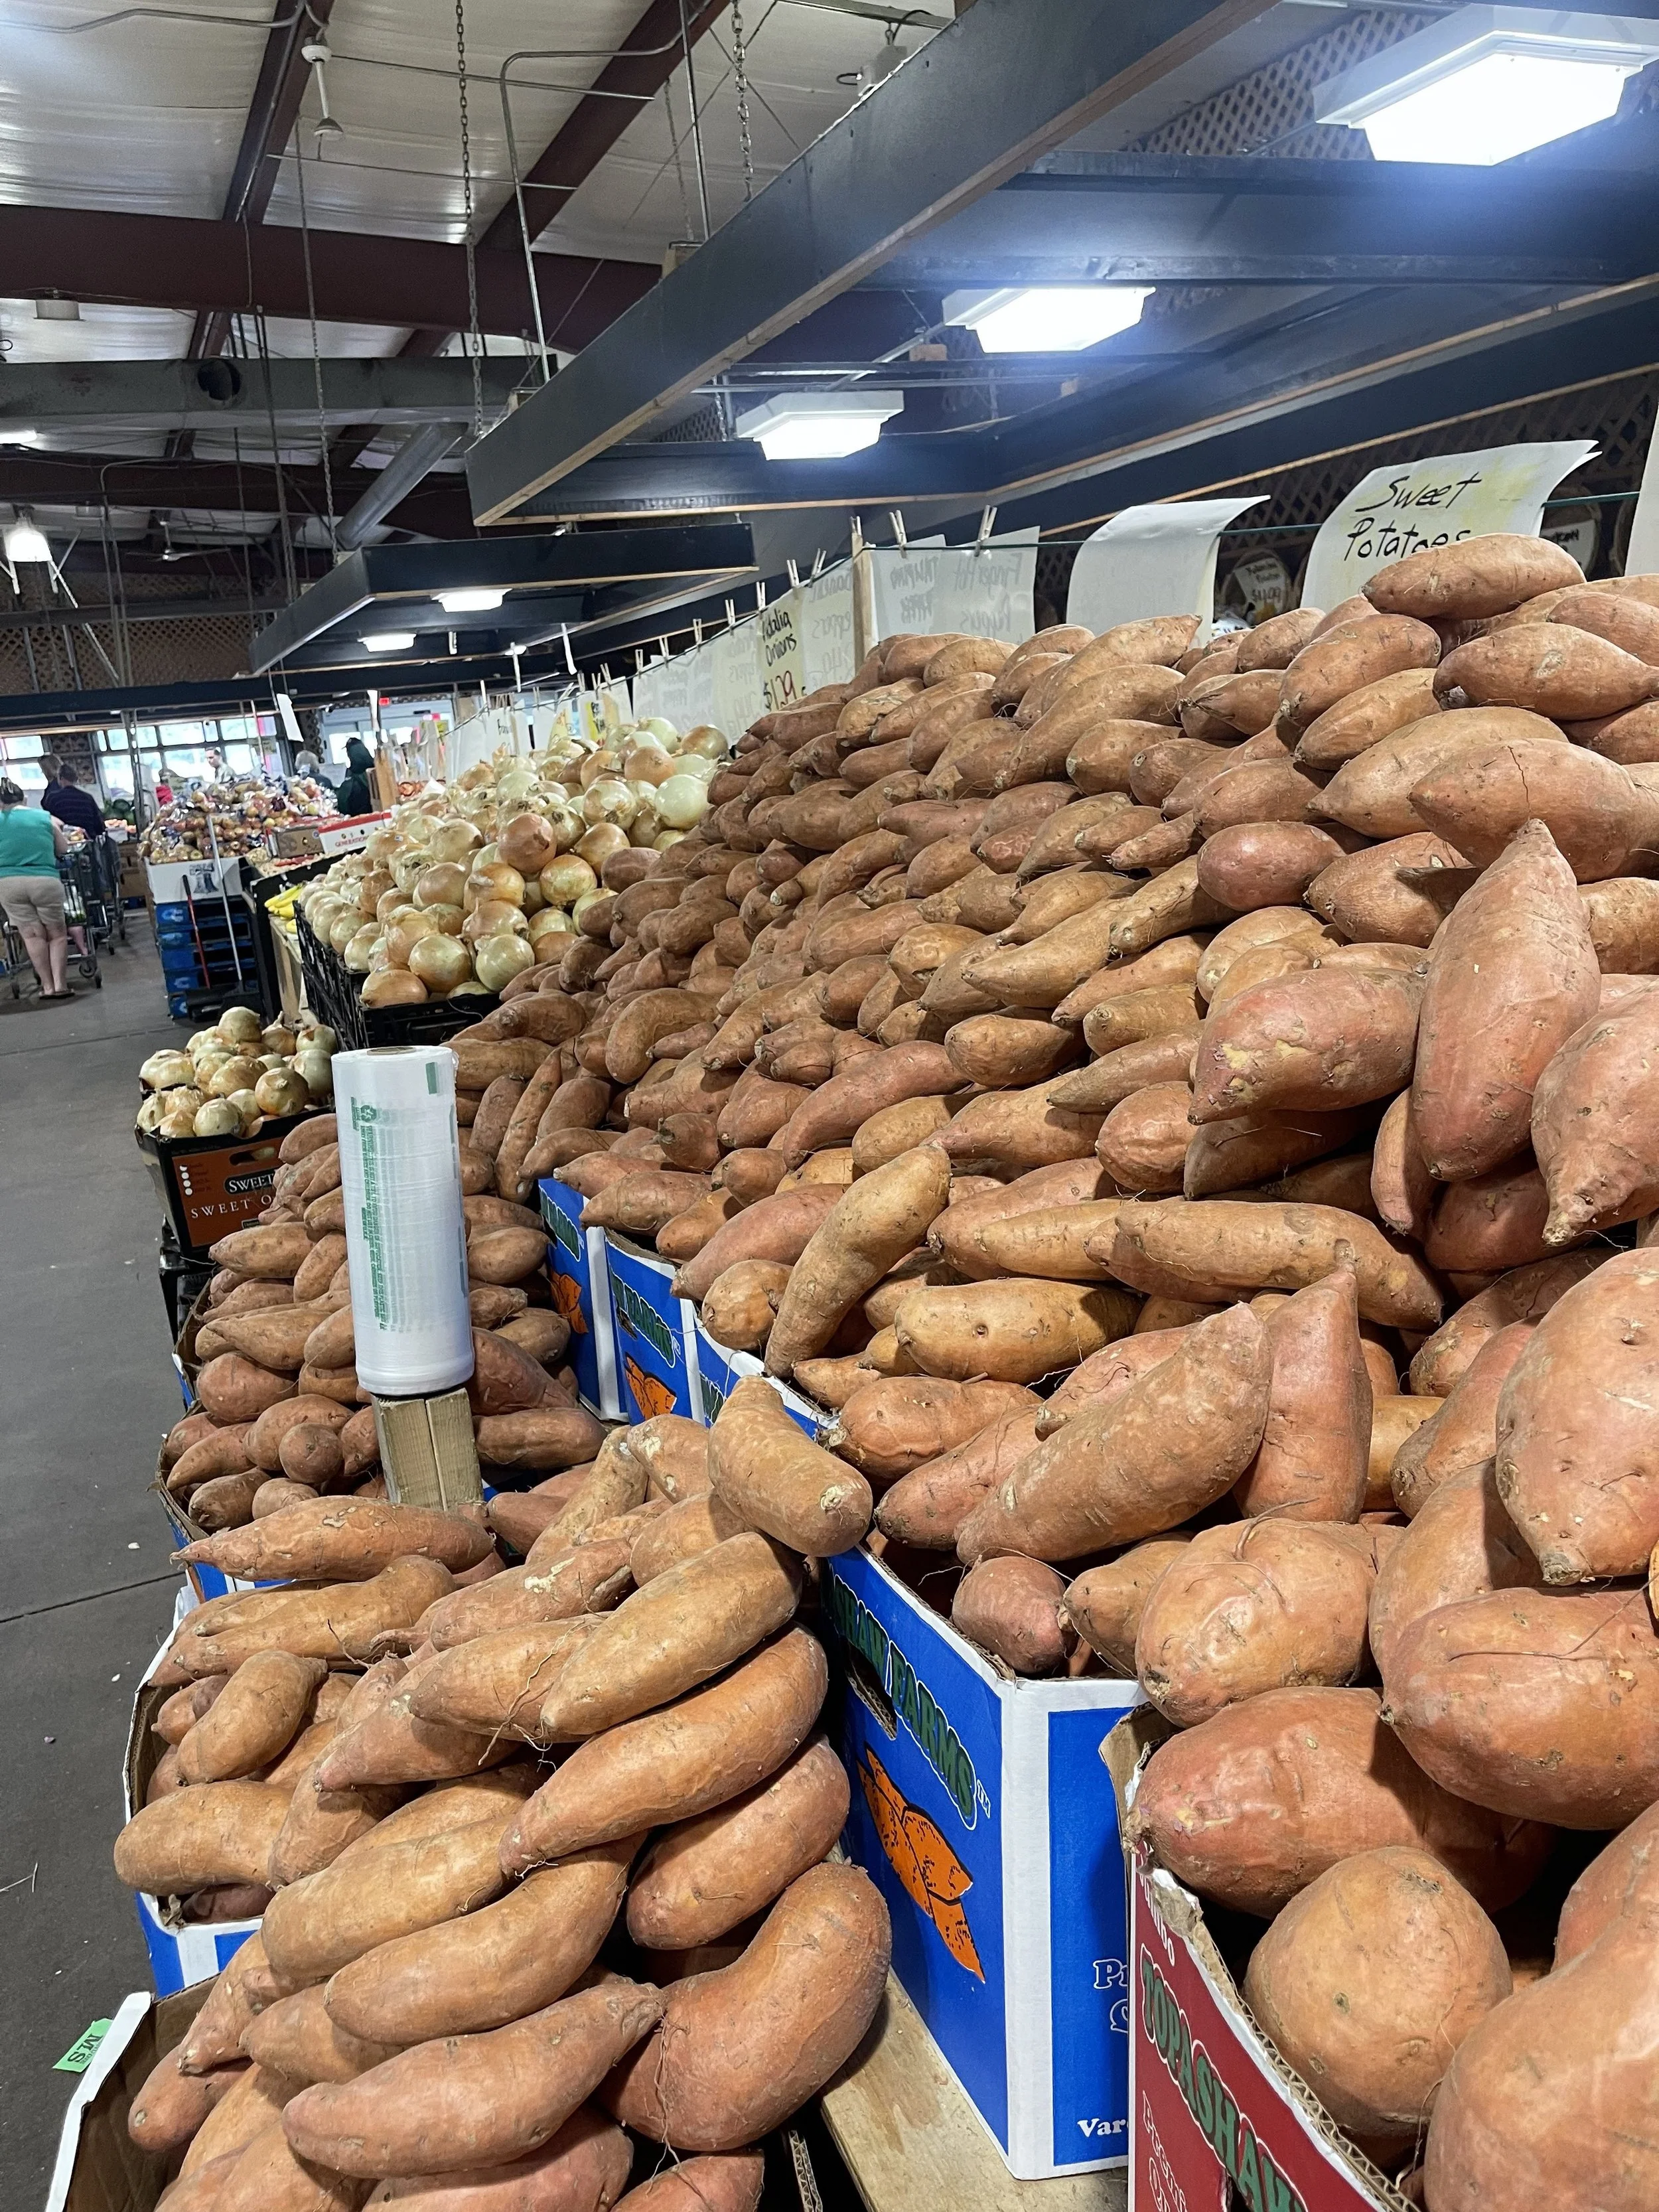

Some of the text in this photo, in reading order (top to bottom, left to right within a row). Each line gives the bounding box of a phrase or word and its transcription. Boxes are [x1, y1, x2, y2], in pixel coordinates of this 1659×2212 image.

[1354, 471, 1482, 513] Sweet
[228, 1173, 274, 1193] SWEET
[190, 1199, 250, 1219] SWEET
[889, 1641, 977, 1830] FARMS
